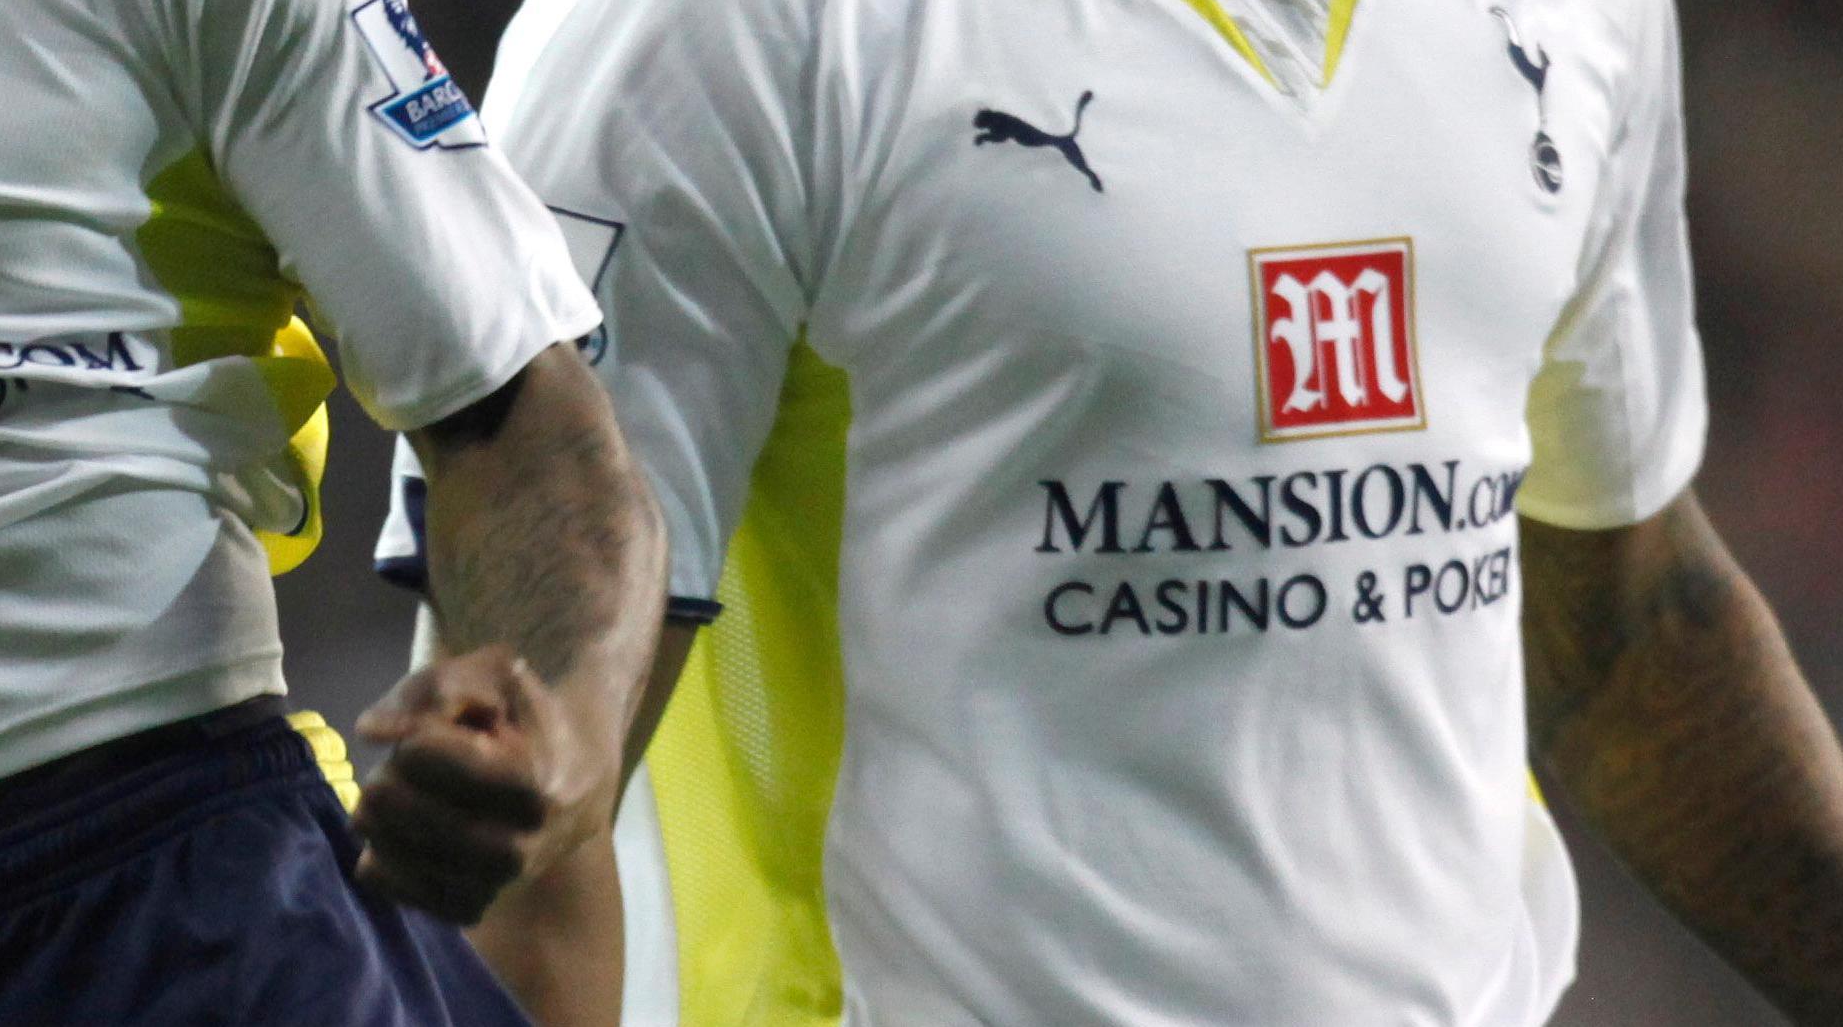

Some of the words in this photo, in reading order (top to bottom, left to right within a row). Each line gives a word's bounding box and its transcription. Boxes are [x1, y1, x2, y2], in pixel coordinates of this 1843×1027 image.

[1270, 267, 1409, 412] M
[1044, 573, 1328, 635] CASINO
[1352, 570, 1386, 622] &
